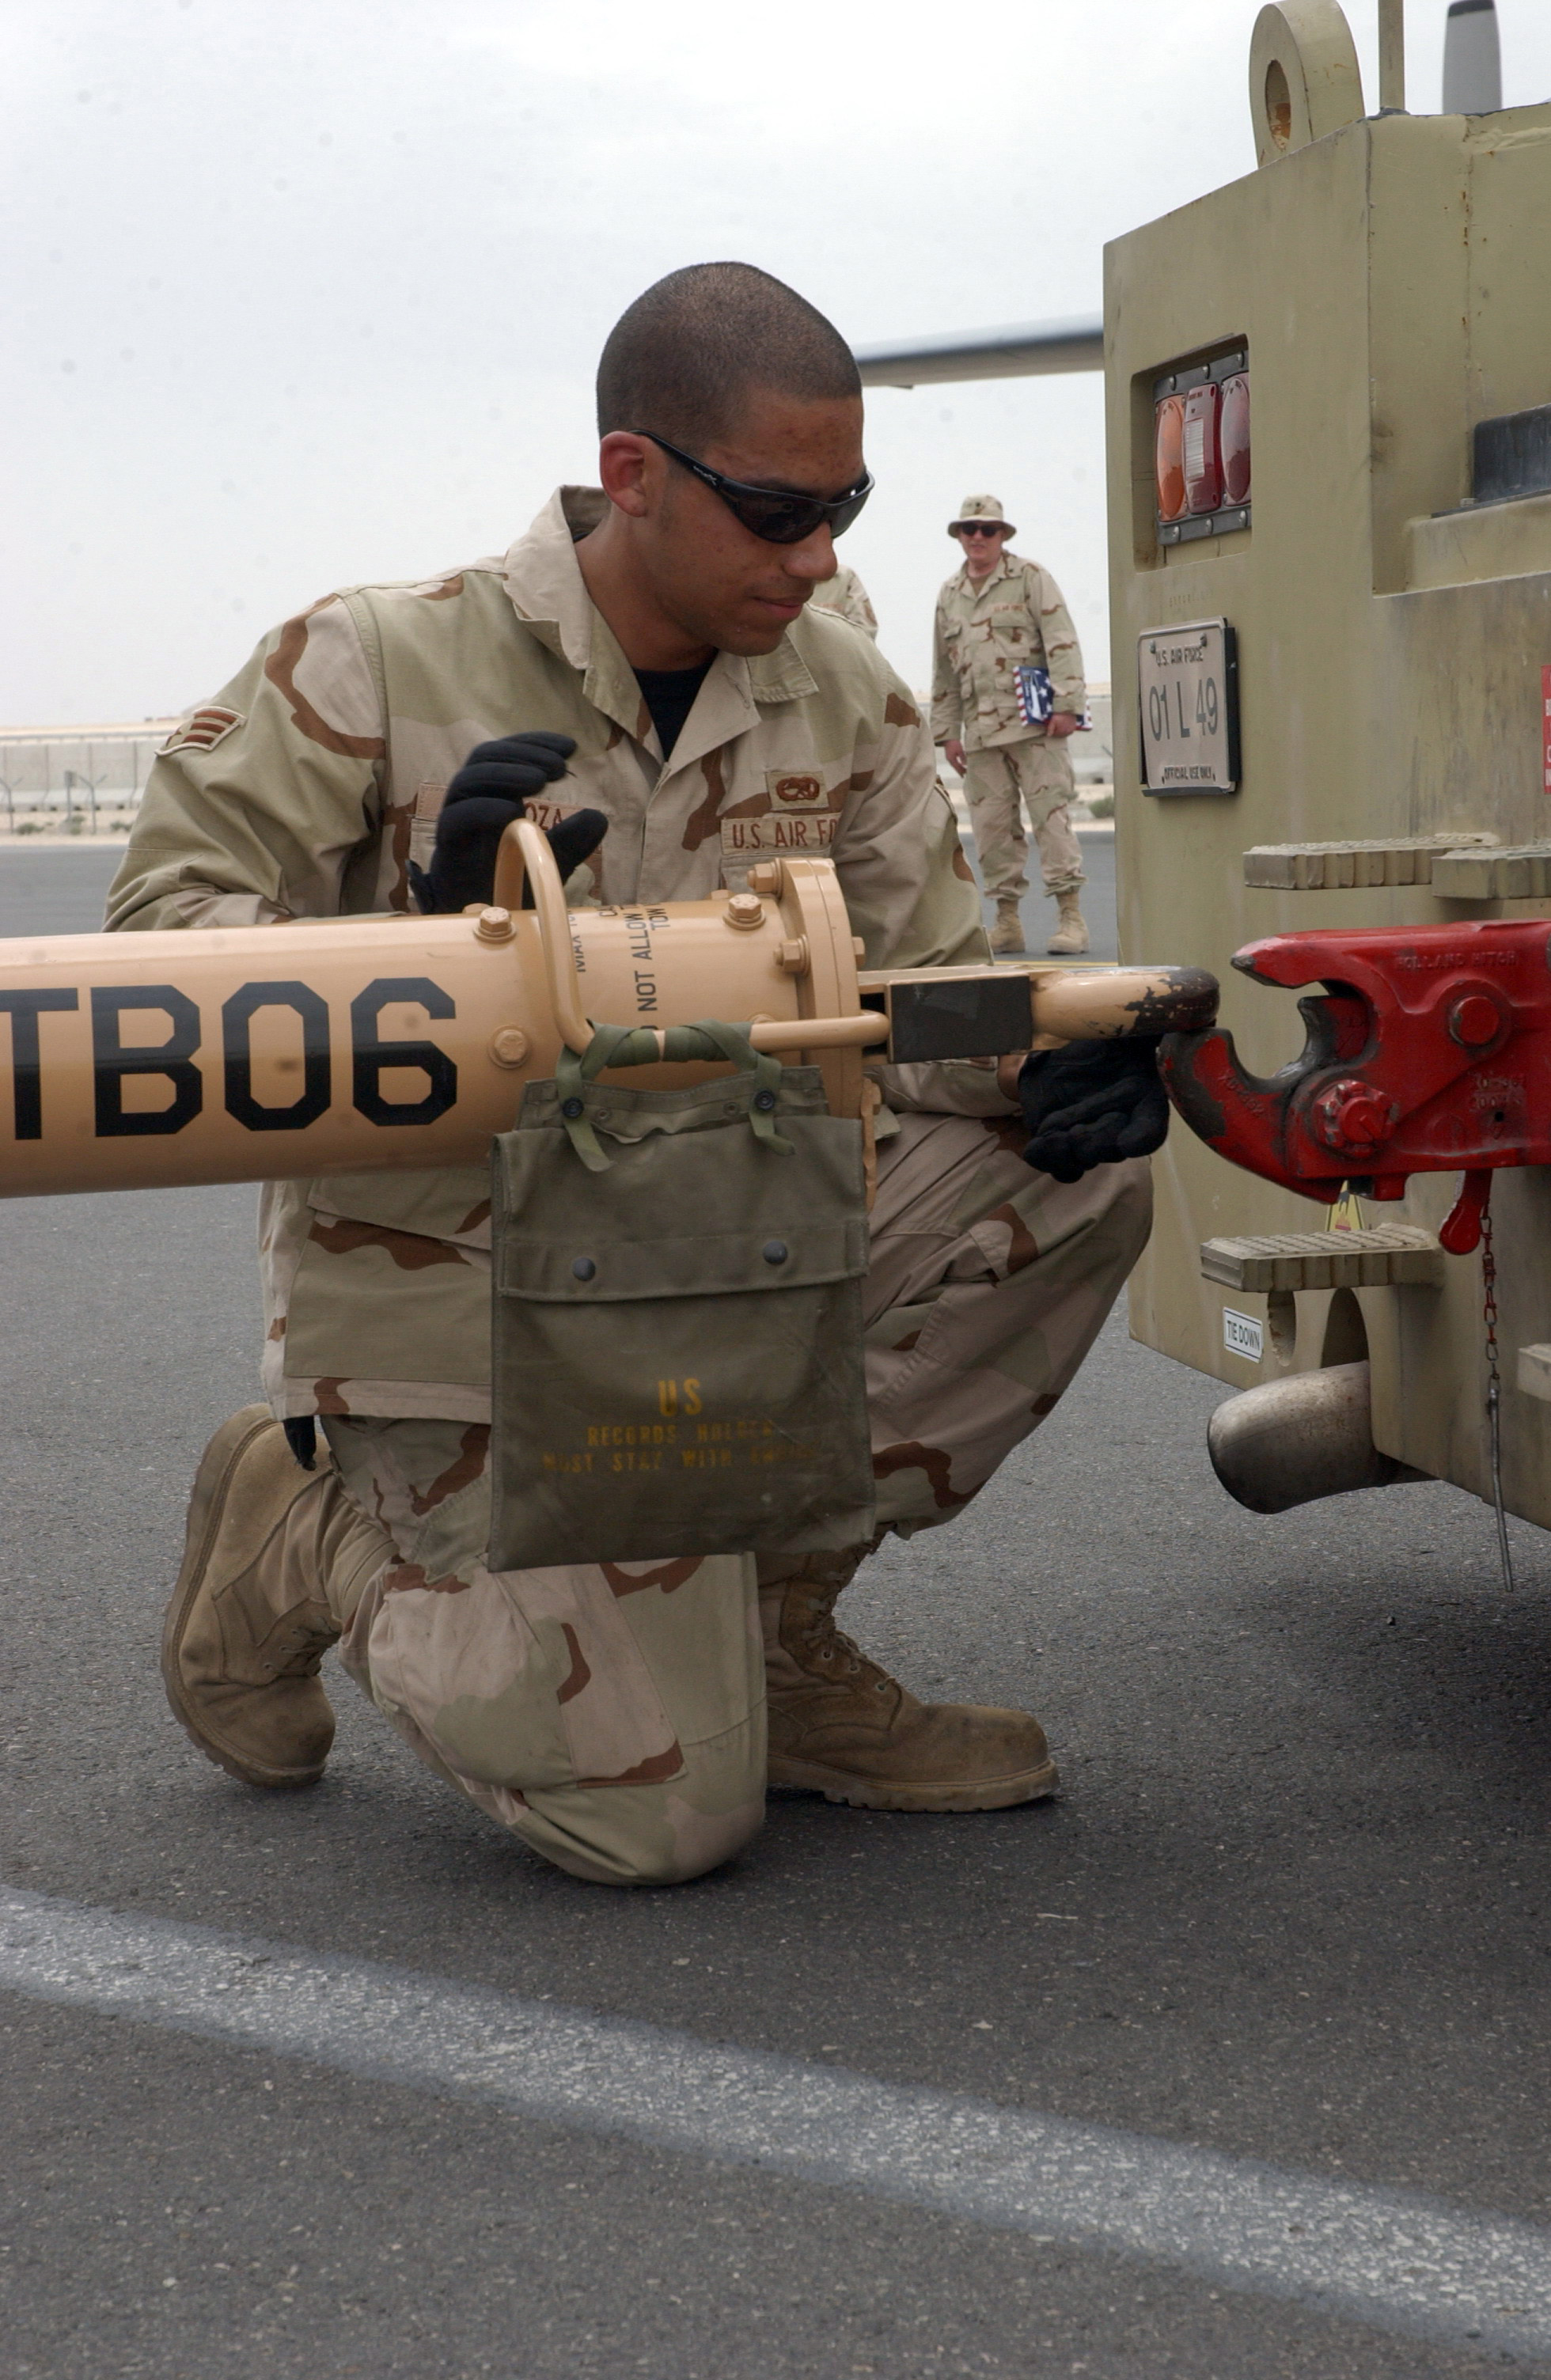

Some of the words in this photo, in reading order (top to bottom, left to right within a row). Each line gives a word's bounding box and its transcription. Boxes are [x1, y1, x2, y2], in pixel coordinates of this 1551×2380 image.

[1170, 648, 1182, 664] AIR
[1184, 646, 1204, 663] FORCE
[1150, 684, 1170, 741] 01
[1177, 680, 1190, 737] L
[1196, 677, 1219, 736] 49
[732, 821, 765, 849] U.S.
[774, 820, 808, 847] AIR
[646, 908, 671, 931] TOW
[623, 912, 653, 961] ALLOW
[634, 970, 658, 1012] NOT
[1227, 1320, 1238, 1342] TIE
[1238, 1325, 1261, 1351] DOWN
[658, 1378, 703, 1417] US
[587, 1425, 677, 1446] RECORDS
[681, 1447, 733, 1468] WITH
